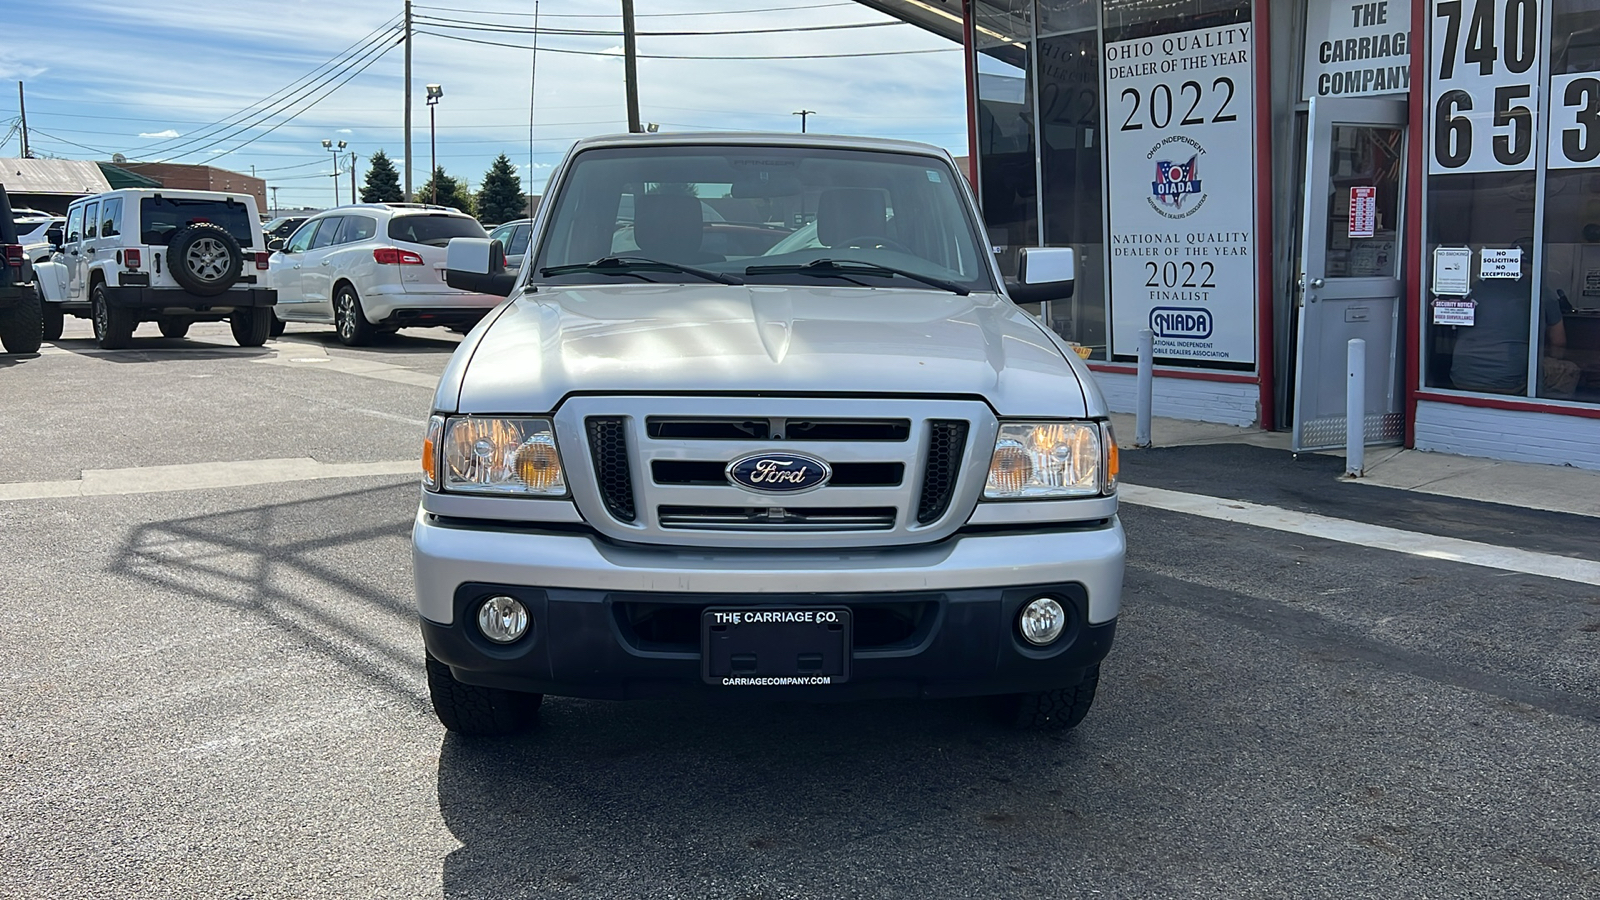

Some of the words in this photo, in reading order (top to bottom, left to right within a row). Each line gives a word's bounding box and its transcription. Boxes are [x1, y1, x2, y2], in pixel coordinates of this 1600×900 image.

[1351, 1, 1387, 28] THE
[1107, 41, 1154, 61] OHIO
[1162, 27, 1250, 56] QUALITY
[1436, 0, 1538, 80] 740
[1109, 61, 1158, 80] DEALER
[1160, 58, 1178, 74] OF
[1180, 55, 1207, 70] THE
[1211, 49, 1248, 67] YEAR
[1318, 65, 1411, 96] COMPANY
[1120, 76, 1237, 131] 2022
[1146, 142, 1161, 160] OHIO
[1161, 135, 1207, 156] INDEPENDENT
[1157, 181, 1193, 194] OIADA
[1146, 196, 1168, 218] AUTOMOBILE
[1185, 193, 1208, 218] ASSOCIATION
[1113, 233, 1181, 244] NATIONAL
[1186, 232, 1249, 245] QUALITY
[1114, 247, 1159, 257] DEALER
[1164, 246, 1180, 256] OF
[1184, 246, 1209, 256] THE
[1214, 246, 1248, 256] YEAR
[1144, 261, 1216, 288] 2022
[1149, 291, 1210, 301] FINALIST
[1154, 313, 1207, 332] NIADA
[1176, 341, 1213, 349] INDEPENDENT
[1192, 350, 1230, 358] ASSOCIATION
[750, 459, 808, 483] Ford
[714, 612, 741, 624] THE
[744, 611, 813, 623] CARRIAGE
[816, 611, 839, 623] CO.
[722, 676, 831, 686] CARRIAGECOMPANY.COM
